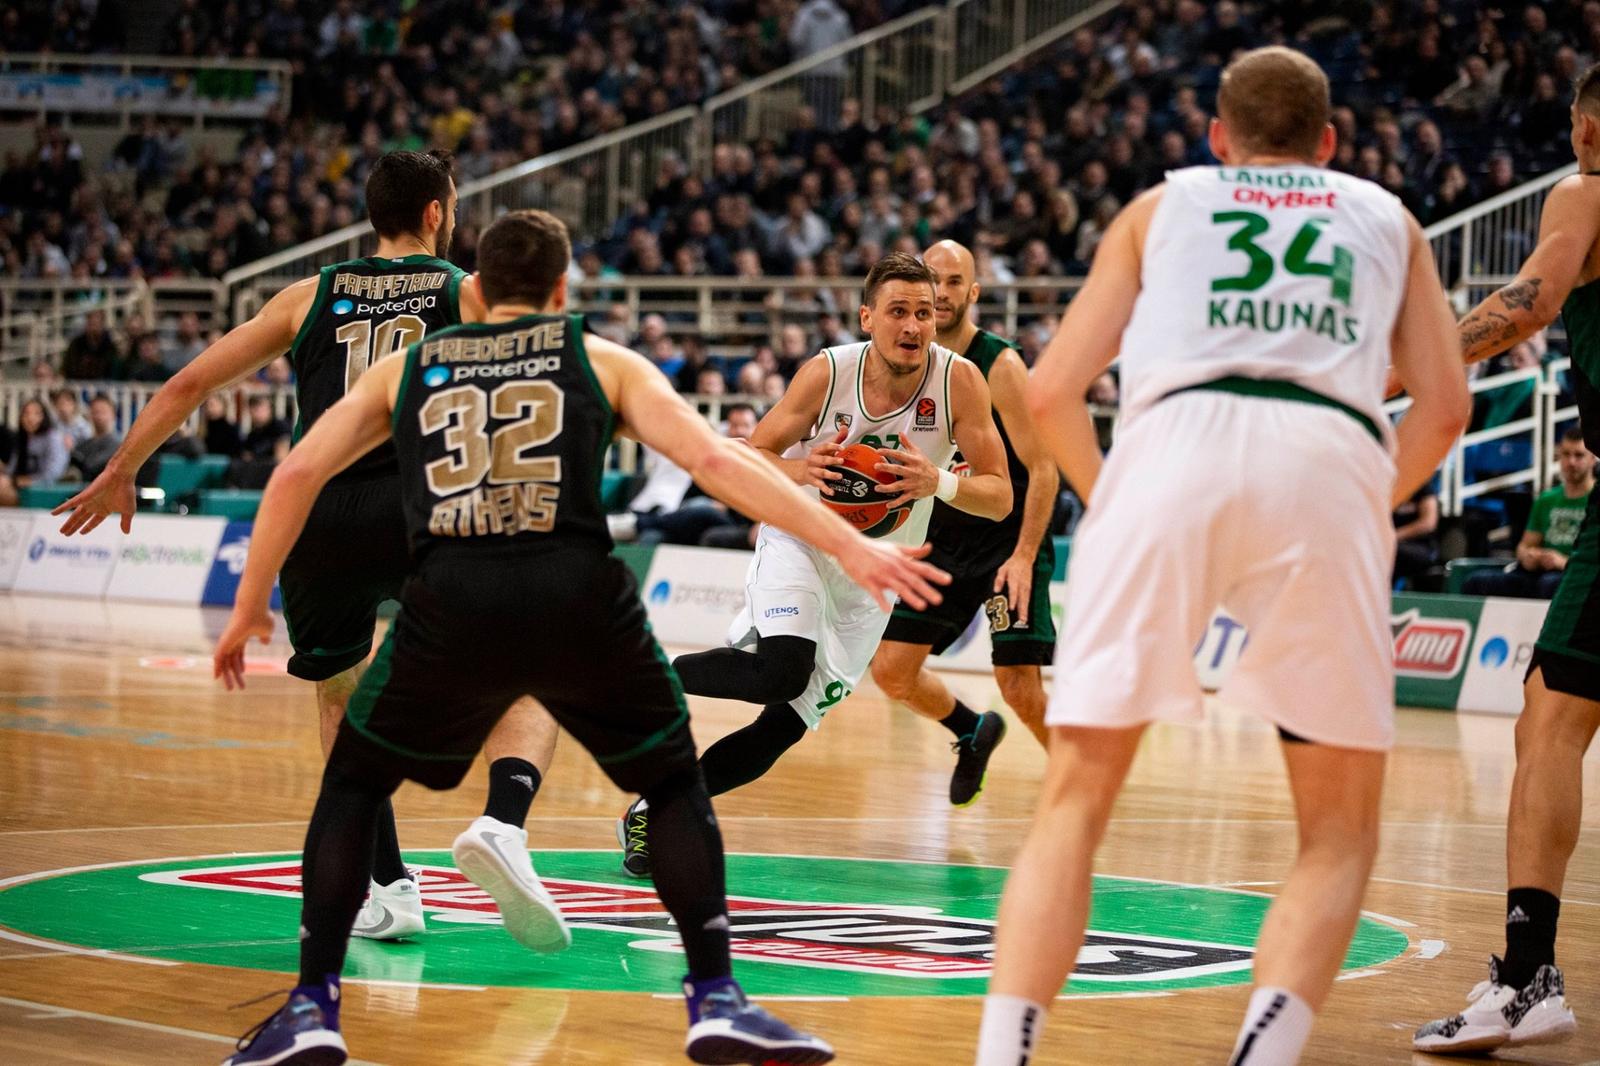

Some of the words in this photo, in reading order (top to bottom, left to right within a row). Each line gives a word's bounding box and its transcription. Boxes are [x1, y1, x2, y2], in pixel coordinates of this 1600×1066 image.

[1233, 188, 1337, 210] OlyBet
[1212, 210, 1353, 308] 34
[333, 272, 447, 299] PAPAPETROU
[357, 295, 436, 315] protergia
[1209, 299, 1358, 345] KAUNAS
[420, 320, 565, 367] FREDETTE
[453, 355, 561, 382] protergia
[418, 380, 564, 497] 32
[428, 482, 560, 536] ATHENS
[764, 606, 799, 618] UTENOS
